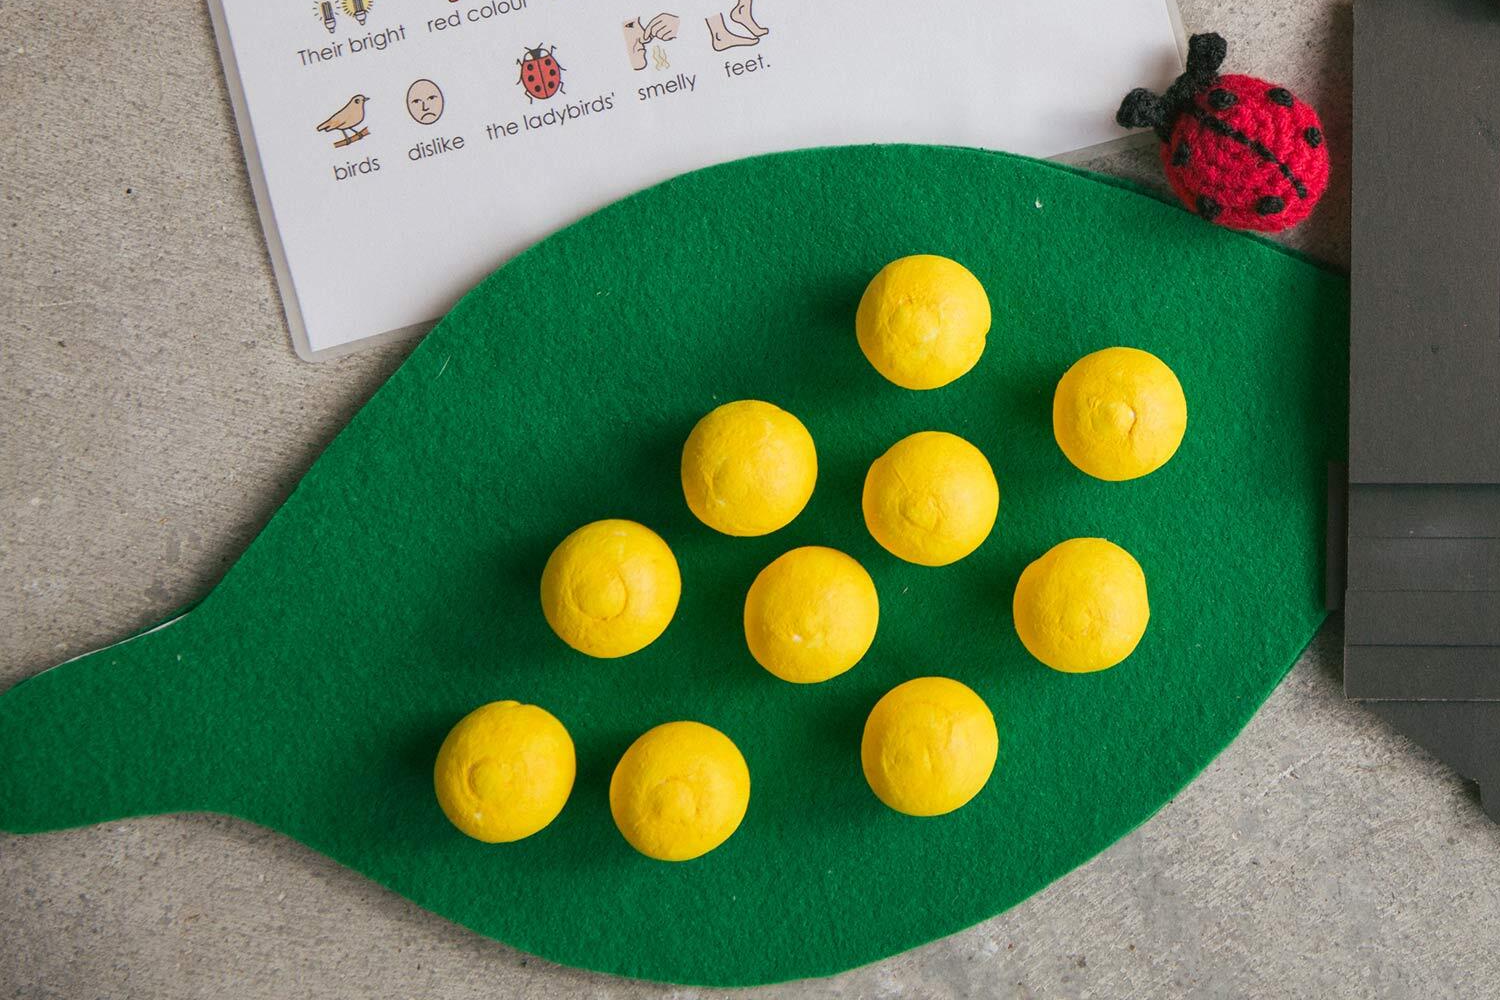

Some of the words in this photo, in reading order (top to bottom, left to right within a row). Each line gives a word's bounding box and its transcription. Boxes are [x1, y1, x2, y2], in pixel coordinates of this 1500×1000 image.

[297, 42, 343, 66] Their
[348, 25, 405, 53] bright
[427, 10, 461, 32] red
[333, 157, 380, 181] birds
[408, 136, 465, 161] dislike
[486, 122, 519, 140] the
[638, 73, 696, 101] smelly
[724, 54, 770, 77] feet.
